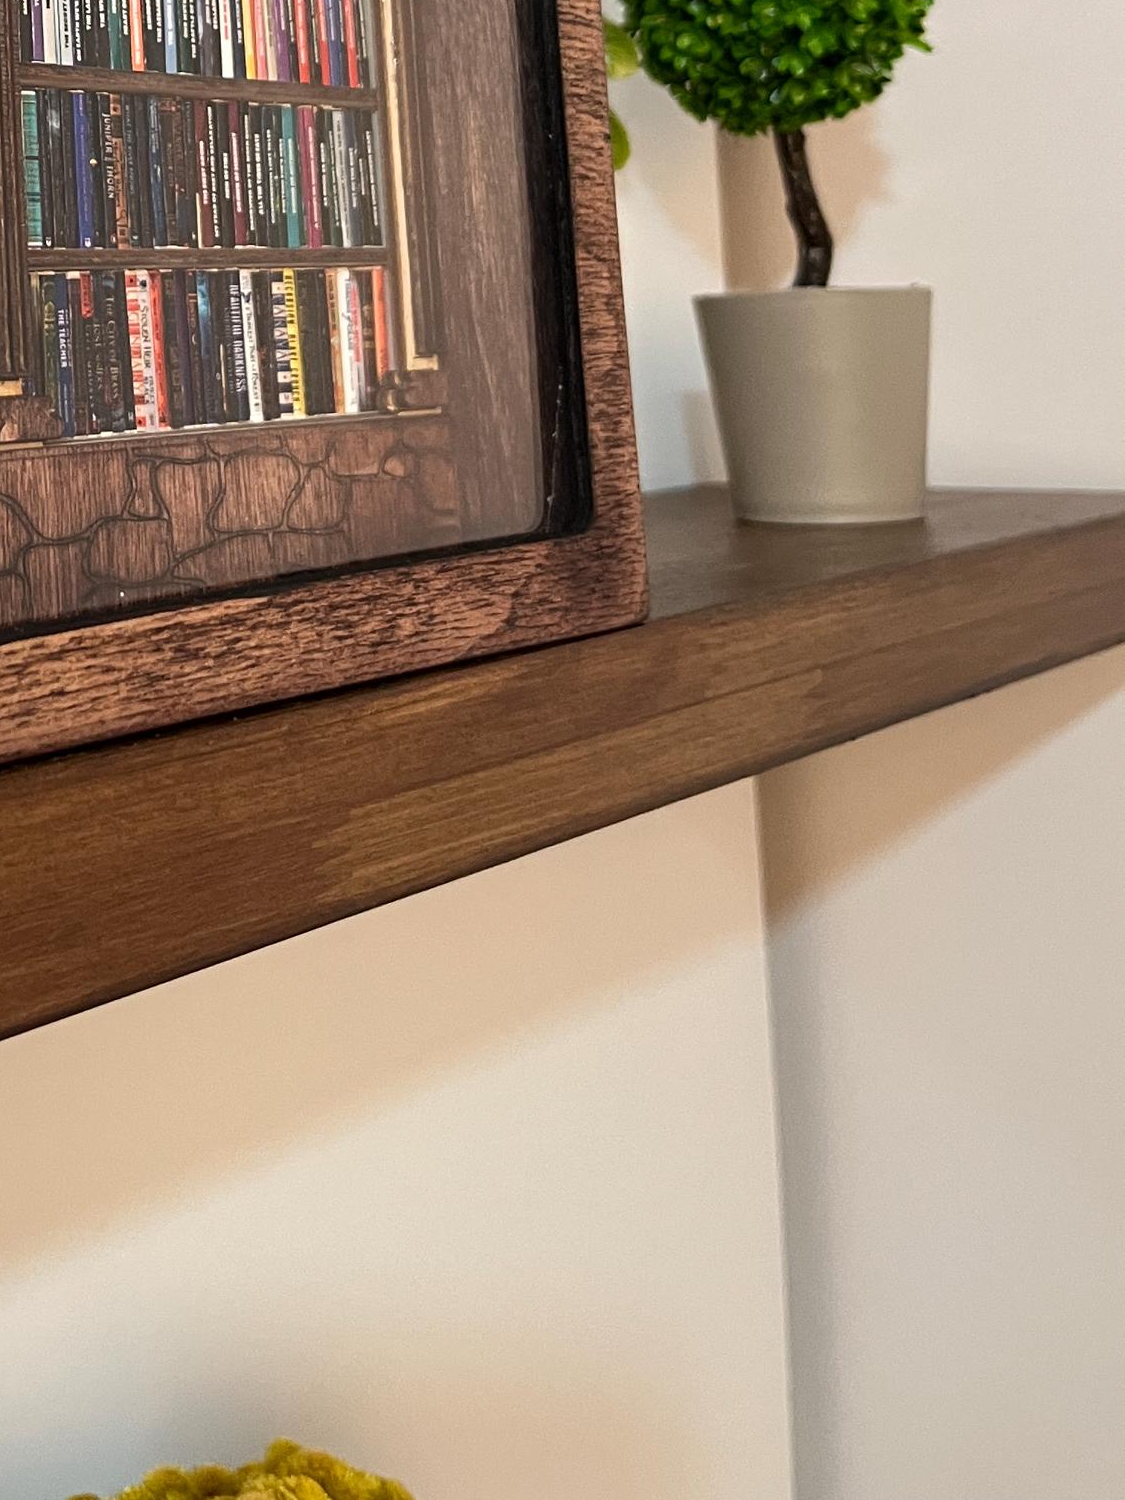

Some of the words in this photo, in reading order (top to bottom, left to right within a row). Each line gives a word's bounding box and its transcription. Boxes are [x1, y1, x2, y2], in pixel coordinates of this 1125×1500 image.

[102, 113, 113, 154] JUNIPER
[106, 165, 114, 198] THORN
[141, 306, 151, 343] STOLEN
[229, 284, 243, 335] BEAUTIFUL
[59, 328, 67, 368] TEACHER
[143, 346, 152, 369] HEIR
[233, 340, 246, 392] DARKNESS
